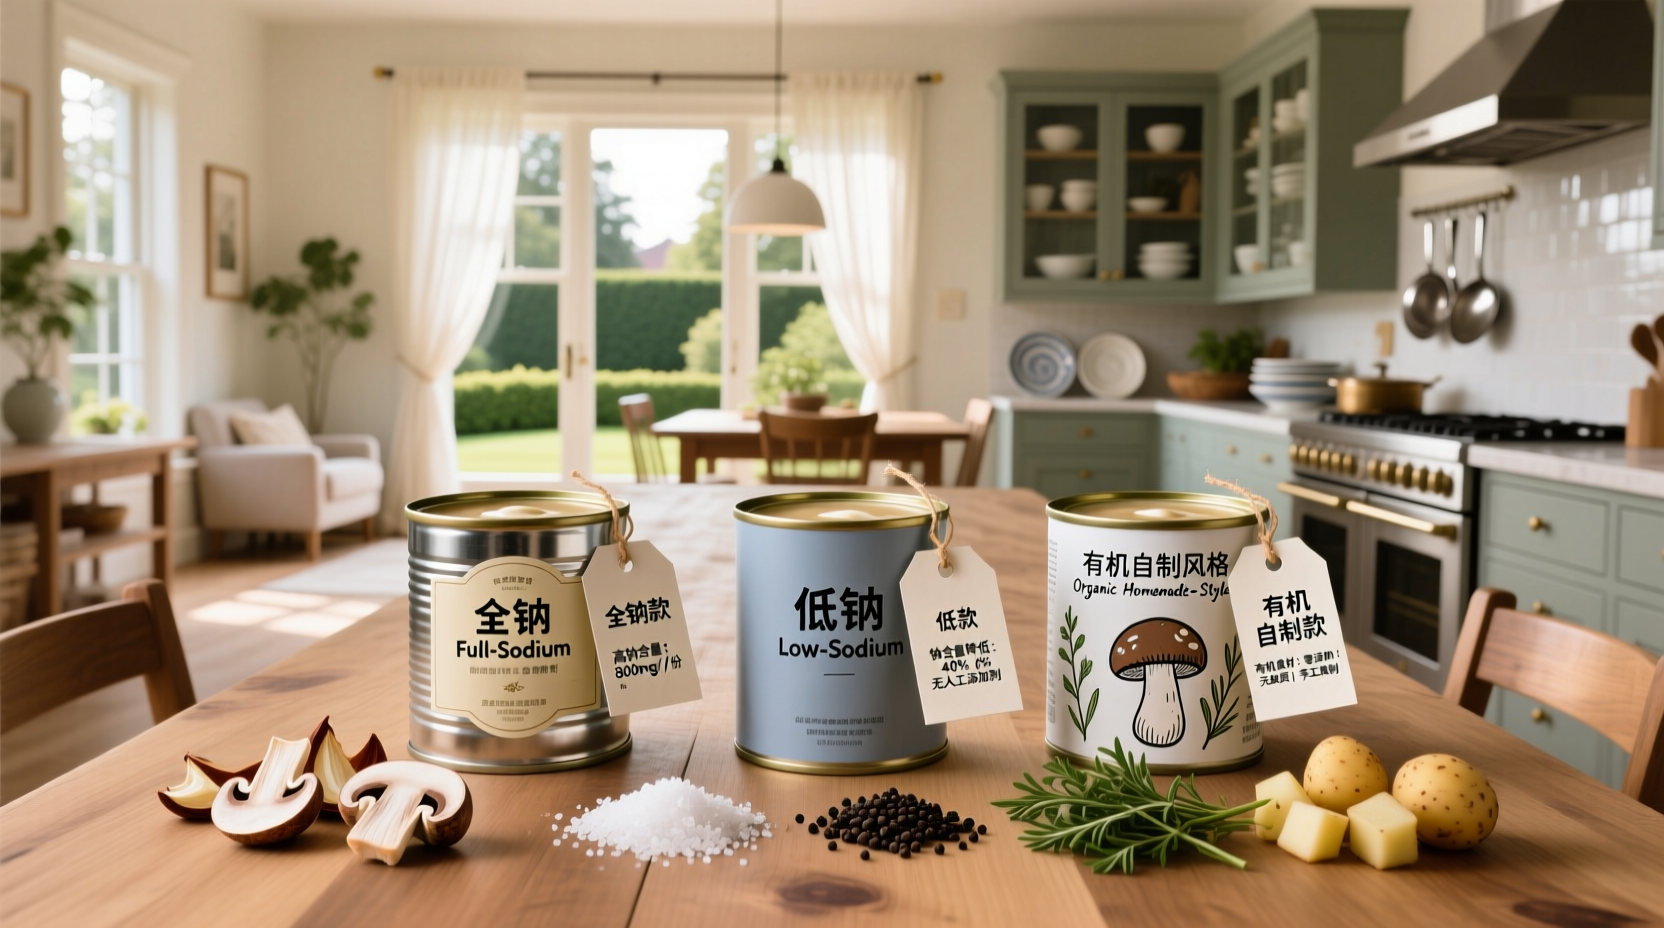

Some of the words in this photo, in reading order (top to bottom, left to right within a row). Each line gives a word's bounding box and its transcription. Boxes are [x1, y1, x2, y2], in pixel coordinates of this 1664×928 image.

[1083, 550, 1229, 579] 有机自制风格
[1073, 578, 1117, 600] Organic
[474, 597, 550, 635] 全钠
[605, 597, 671, 629] 全钠款
[794, 586, 883, 631] 低钠
[1262, 590, 1311, 618] 有机
[936, 606, 978, 632] 低款
[1257, 613, 1327, 648] 自制款
[456, 640, 571, 659] Full-Sodium
[779, 637, 904, 659] Low-Sodium
